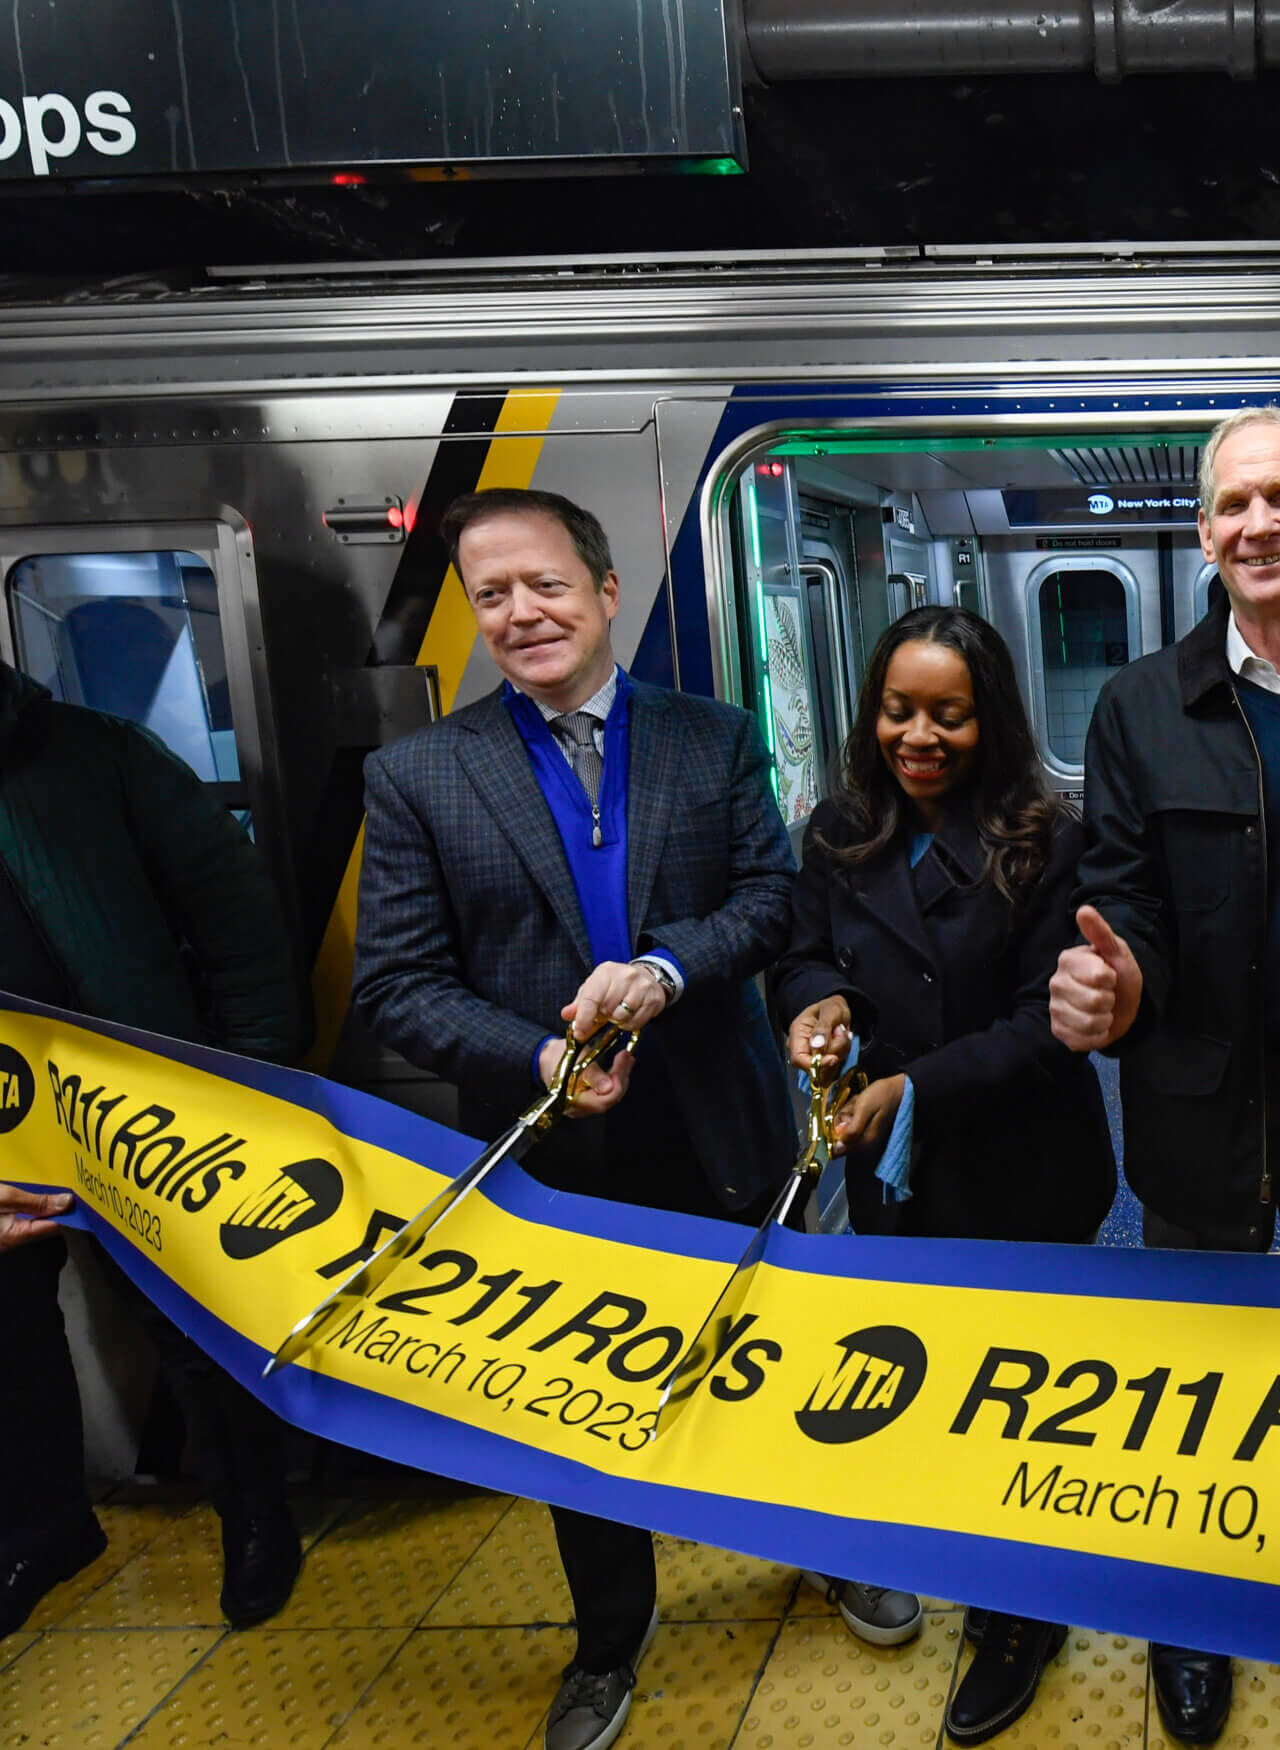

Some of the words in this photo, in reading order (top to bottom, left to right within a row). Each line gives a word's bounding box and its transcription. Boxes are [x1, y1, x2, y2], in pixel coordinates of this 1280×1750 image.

[1117, 500, 1143, 508] New
[1145, 499, 1171, 507] York
[1173, 498, 1196, 508] City
[959, 554, 969, 563] R1
[48, 1060, 128, 1161] R211
[108, 1104, 247, 1213] Rolls
[75, 1152, 110, 1208] March
[125, 1196, 162, 1252] 2023
[229, 1175, 316, 1231] MTA
[326, 1310, 467, 1384] March
[467, 1357, 527, 1411] 10,
[523, 1376, 657, 1451] 2023
[949, 1347, 1223, 1456] R211
[1001, 1462, 1180, 1528] March
[1196, 1483, 1266, 1554] 10,
